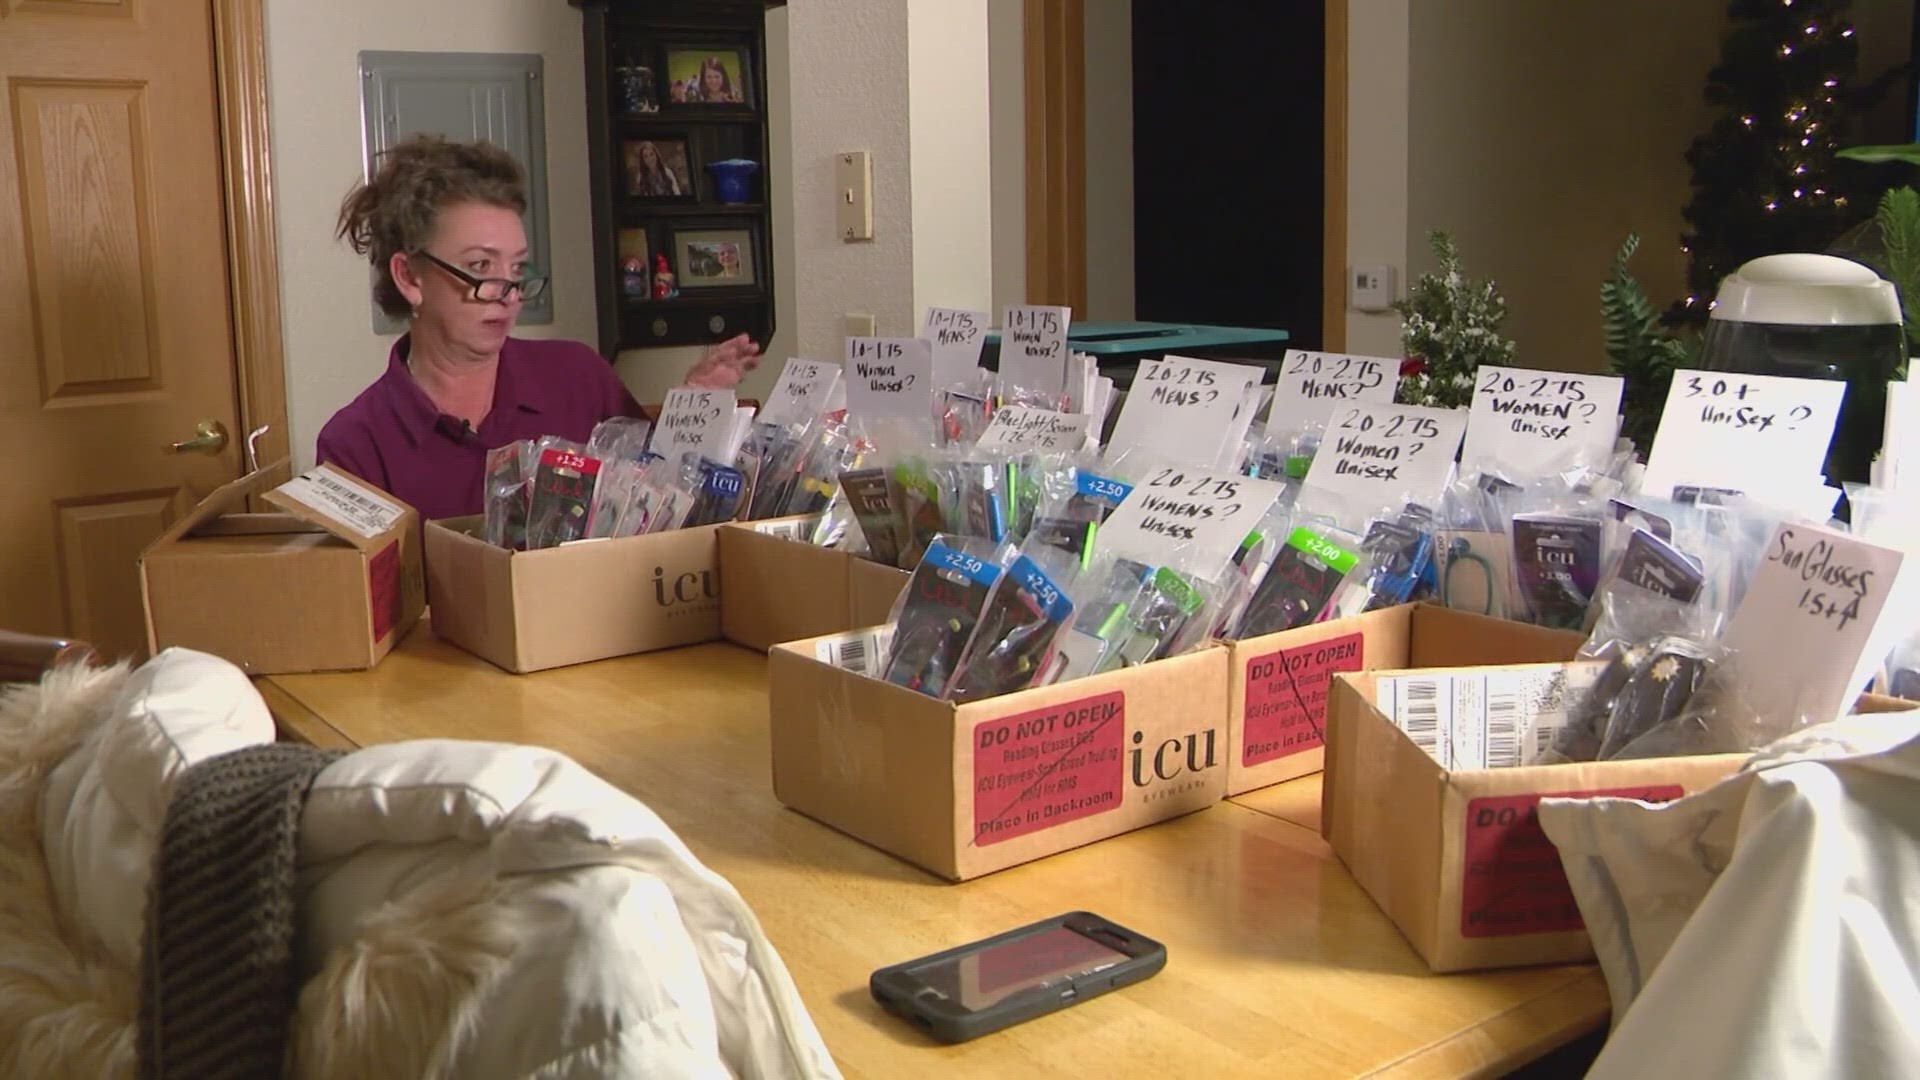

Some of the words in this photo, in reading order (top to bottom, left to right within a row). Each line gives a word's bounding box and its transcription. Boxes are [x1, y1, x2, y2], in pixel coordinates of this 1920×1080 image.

[556, 455, 585, 469] +1.25
[712, 472, 739, 492] icu
[1088, 480, 1123, 498] +2.50
[1305, 537, 1342, 561] +2.00
[1537, 546, 1575, 566] icu
[945, 553, 983, 574] +2.50
[1026, 573, 1059, 605] +2.50
[1251, 661, 1274, 680] DO
[1279, 653, 1313, 674] NOT
[1316, 642, 1357, 665] OPEN
[980, 727, 1010, 748] DO
[1016, 714, 1059, 740] NOT
[1063, 702, 1116, 728] OPEN
[1247, 740, 1280, 757] Place
[1283, 735, 1294, 747] in
[1128, 729, 1218, 787] icu
[979, 816, 1022, 834] Place
[1026, 809, 1039, 823] in
[1044, 791, 1114, 818] Backroom
[1475, 806, 1518, 829] DO
